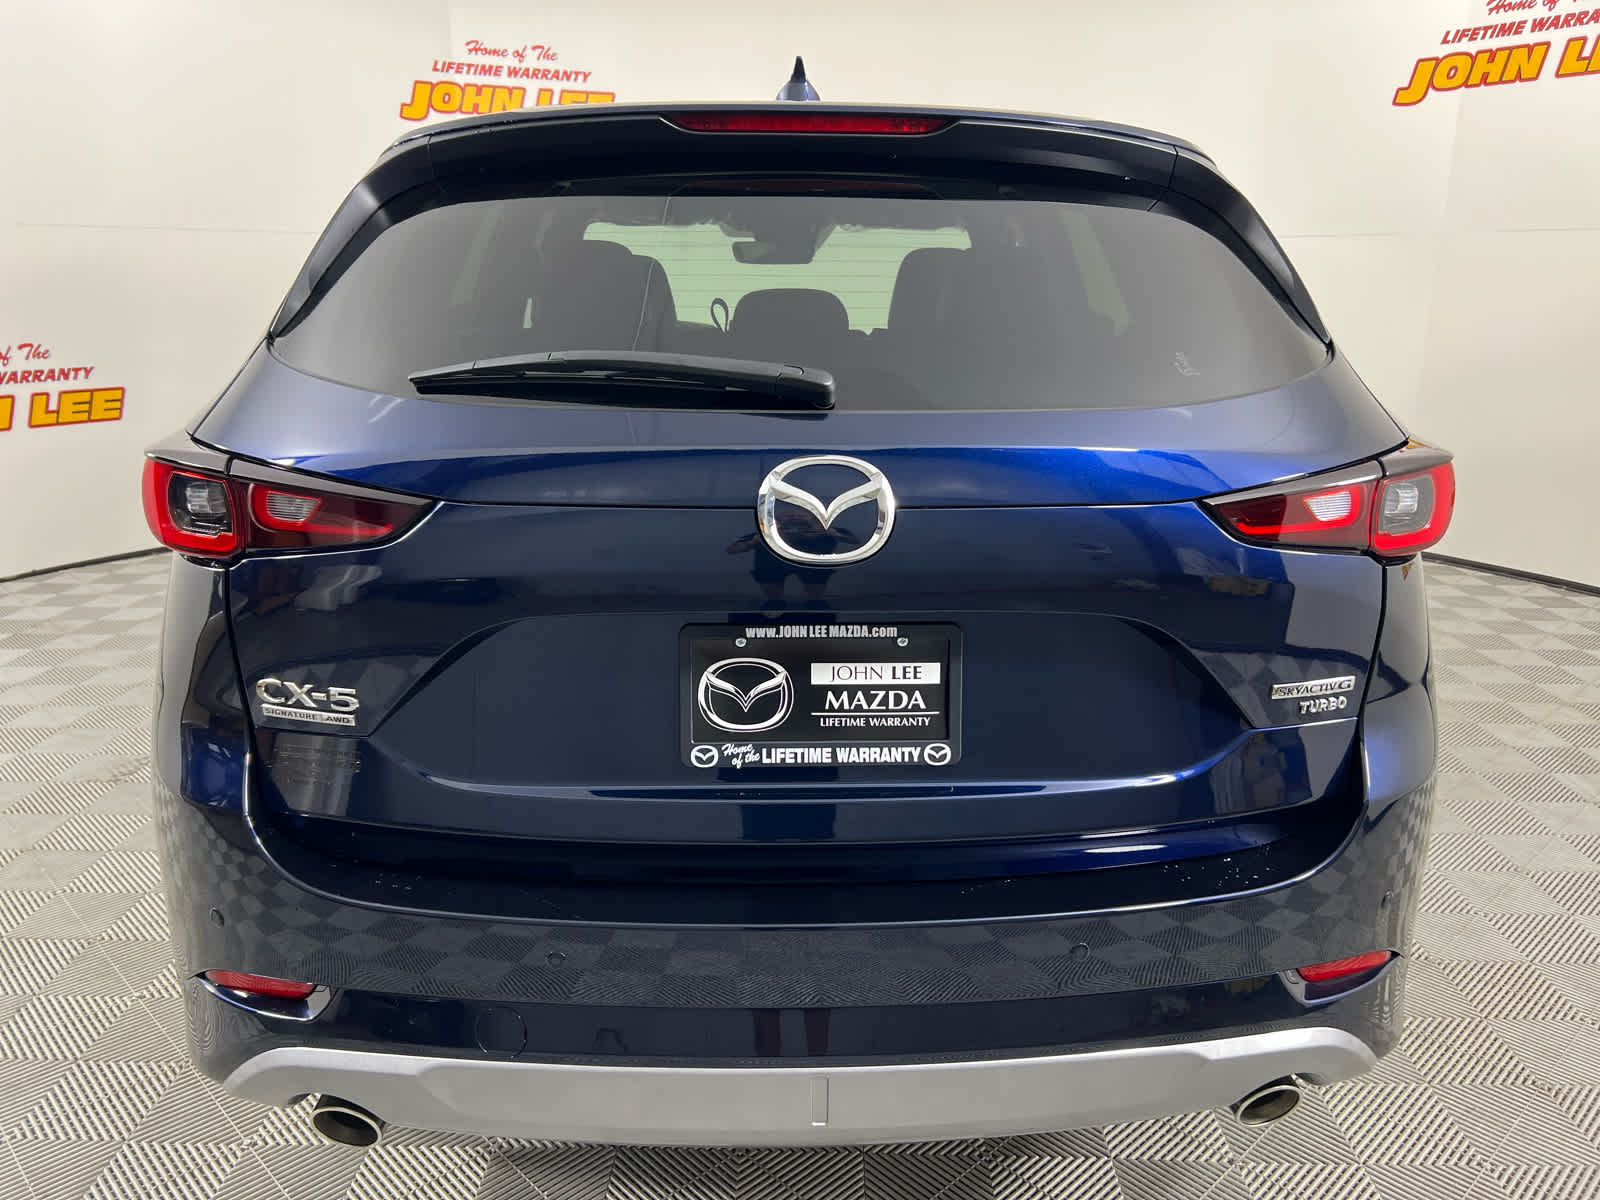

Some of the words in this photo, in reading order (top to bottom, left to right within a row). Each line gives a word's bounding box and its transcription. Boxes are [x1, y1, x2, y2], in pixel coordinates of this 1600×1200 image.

[1440, 19, 1528, 45] LIFETIME
[465, 39, 509, 57] Home
[513, 49, 528, 63] of
[531, 45, 559, 61] The
[432, 60, 504, 77] LIFETIME
[507, 66, 592, 83] WARRANTY
[1392, 41, 1551, 106] JOHN
[400, 80, 526, 121] JOHN
[18, 343, 50, 360] The
[28, 386, 126, 429] LEE
[829, 665, 883, 682] JOHN
[891, 665, 923, 680] LEE
[256, 678, 360, 711] CX-5
[825, 690, 927, 710] MAZDA
[1299, 696, 1348, 714] TURBO
[264, 706, 319, 721] SIGNATURE
[325, 715, 351, 725] AWD
[820, 717, 867, 727] LIFETIME
[869, 716, 931, 727] WARRANTY
[721, 743, 754, 757] Home
[744, 750, 760, 763] the
[761, 747, 832, 764] LIFETIME
[836, 745, 922, 763] WARRANTY
[731, 753, 744, 769] of
